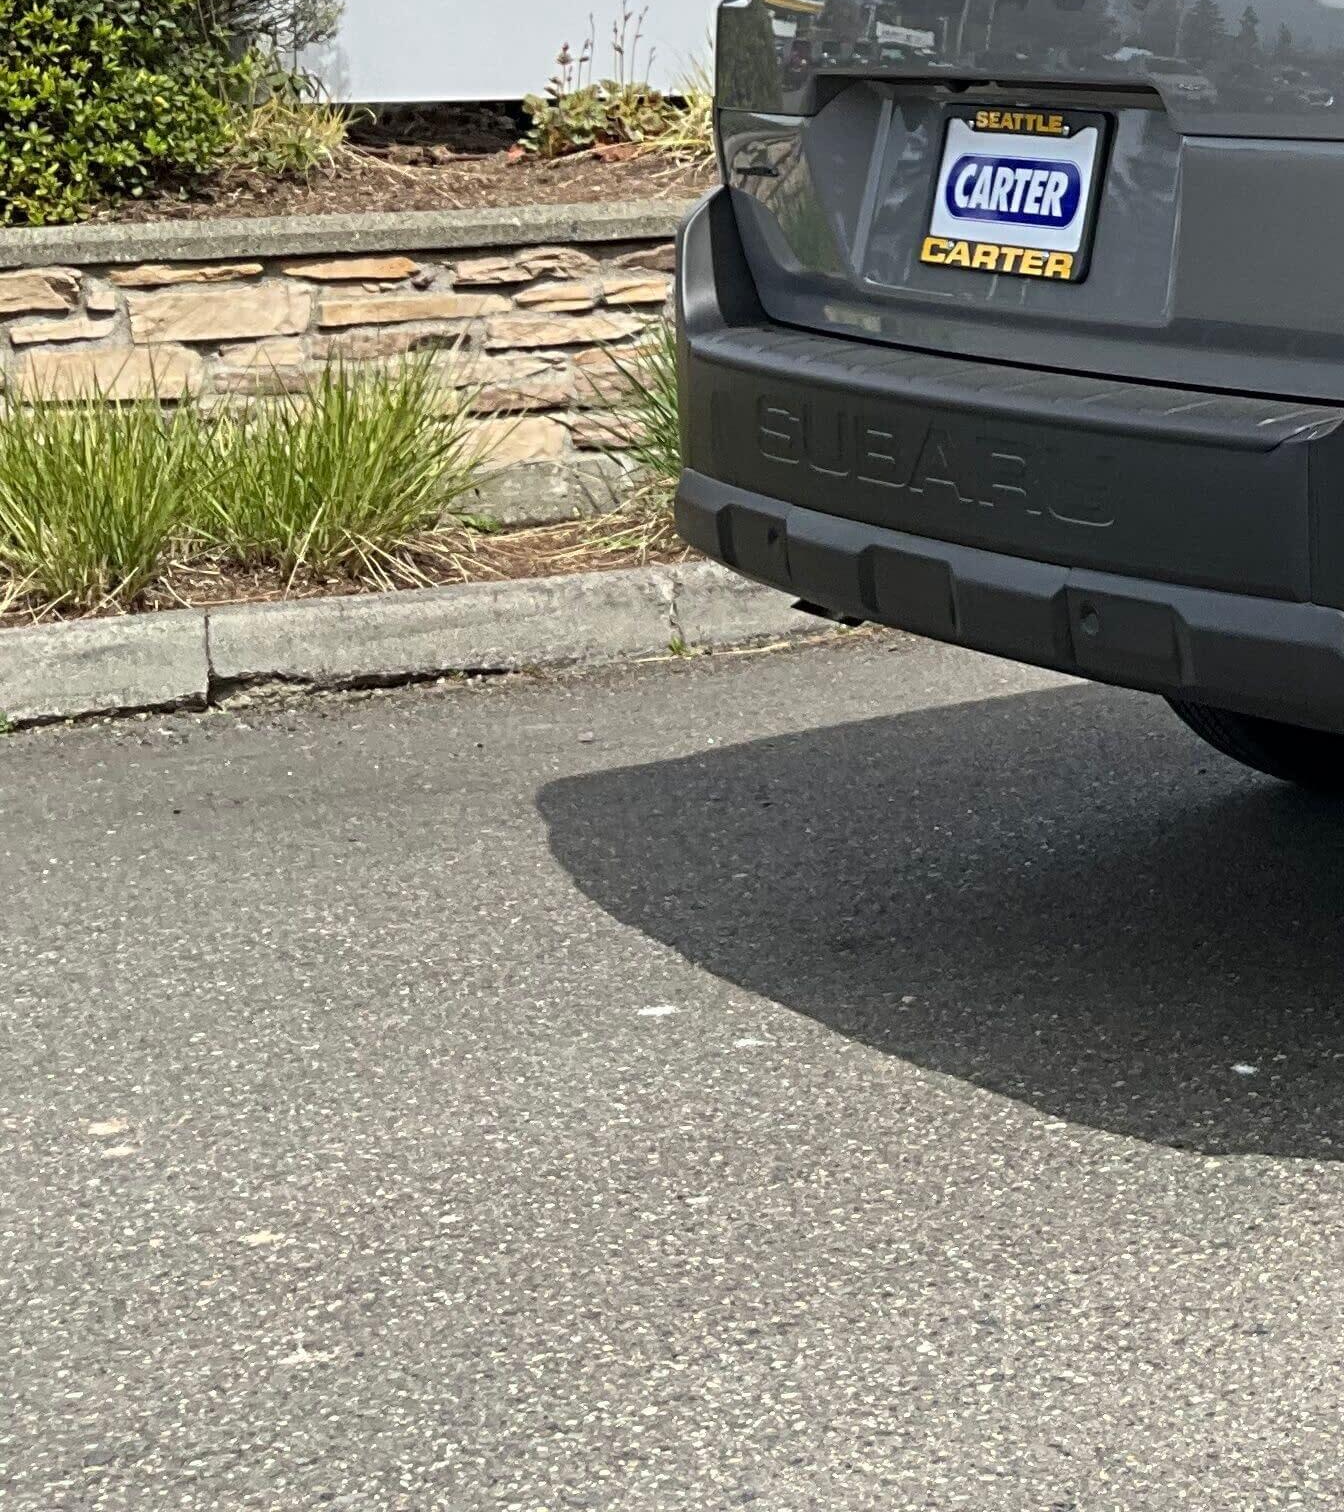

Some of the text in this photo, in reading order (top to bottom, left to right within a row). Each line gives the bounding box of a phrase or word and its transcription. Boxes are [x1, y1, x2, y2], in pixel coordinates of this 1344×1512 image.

[976, 110, 1064, 134] SEATTLE
[954, 162, 1070, 218] CARTER
[920, 235, 1075, 280] CARTER
[757, 394, 1117, 528] SUBARU
